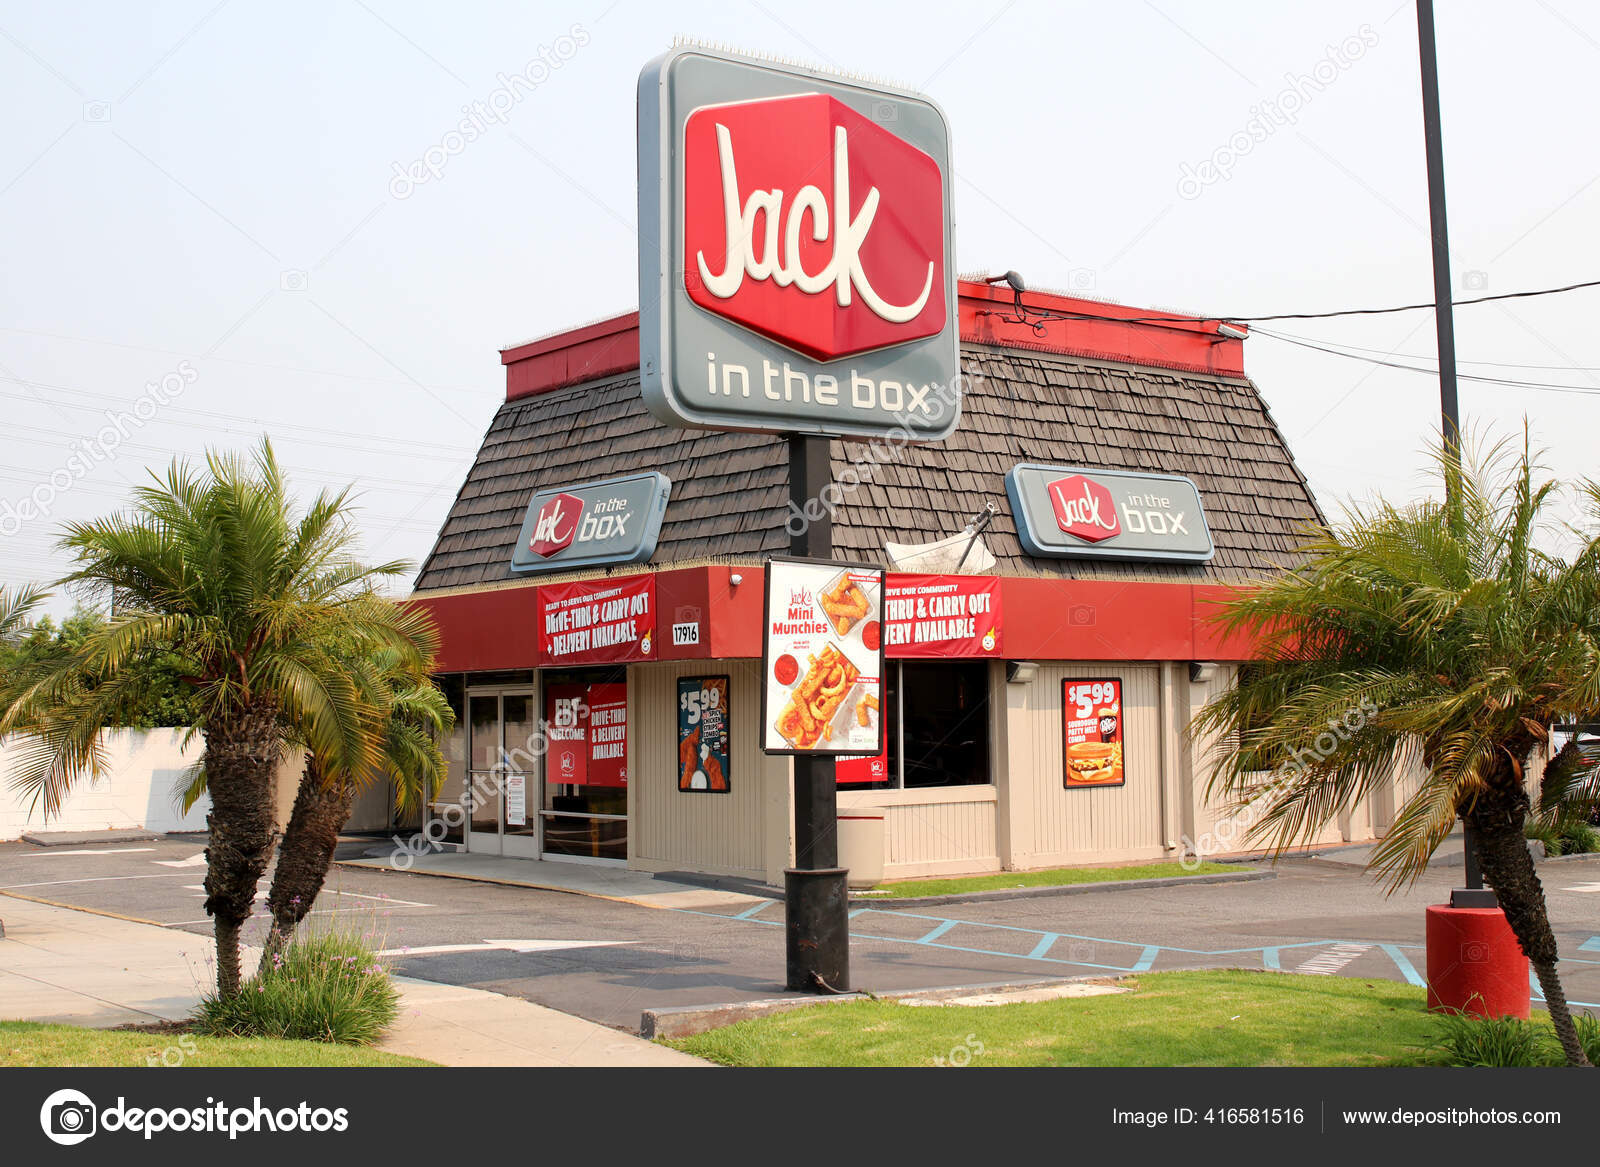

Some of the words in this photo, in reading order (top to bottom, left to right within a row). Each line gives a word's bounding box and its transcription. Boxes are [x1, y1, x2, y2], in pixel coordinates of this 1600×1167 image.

[696, 122, 934, 323] Jack
[707, 352, 750, 398] in
[763, 359, 839, 405] the
[851, 369, 931, 414] box
[594, 500, 606, 514] in
[606, 498, 627, 512] the
[1059, 481, 1116, 531] Jack
[1121, 502, 1189, 536] box
[1127, 491, 1143, 505] in
[1143, 493, 1171, 509] the
[578, 512, 631, 542] box
[901, 587, 916, 595] OUR
[917, 584, 958, 594] COMMUNITY
[545, 601, 560, 611] READY
[561, 600, 568, 608] TO
[568, 596, 583, 606] SERVE
[583, 594, 594, 602] OUR
[594, 587, 623, 600] COMMUNITY
[916, 598, 927, 619] &
[929, 595, 966, 618] CARRY
[968, 593, 991, 615] OUT
[545, 605, 591, 635] DRIVE-THRU
[592, 604, 600, 624] &
[601, 597, 630, 623] CARRY
[630, 592, 649, 616] OUT
[788, 607, 814, 621] Mini
[674, 625, 697, 642] 17916
[772, 621, 828, 635] Munchies
[914, 618, 976, 643] AVAILABLE
[553, 629, 591, 656] DELIVERY
[592, 620, 637, 649] AVAILABLE
[591, 708, 626, 726] DRIVE-THRU
[550, 728, 585, 740] WELCOME
[592, 729, 597, 743] &
[597, 725, 626, 742] DELIVERY
[592, 742, 624, 760] AVAILABLE
